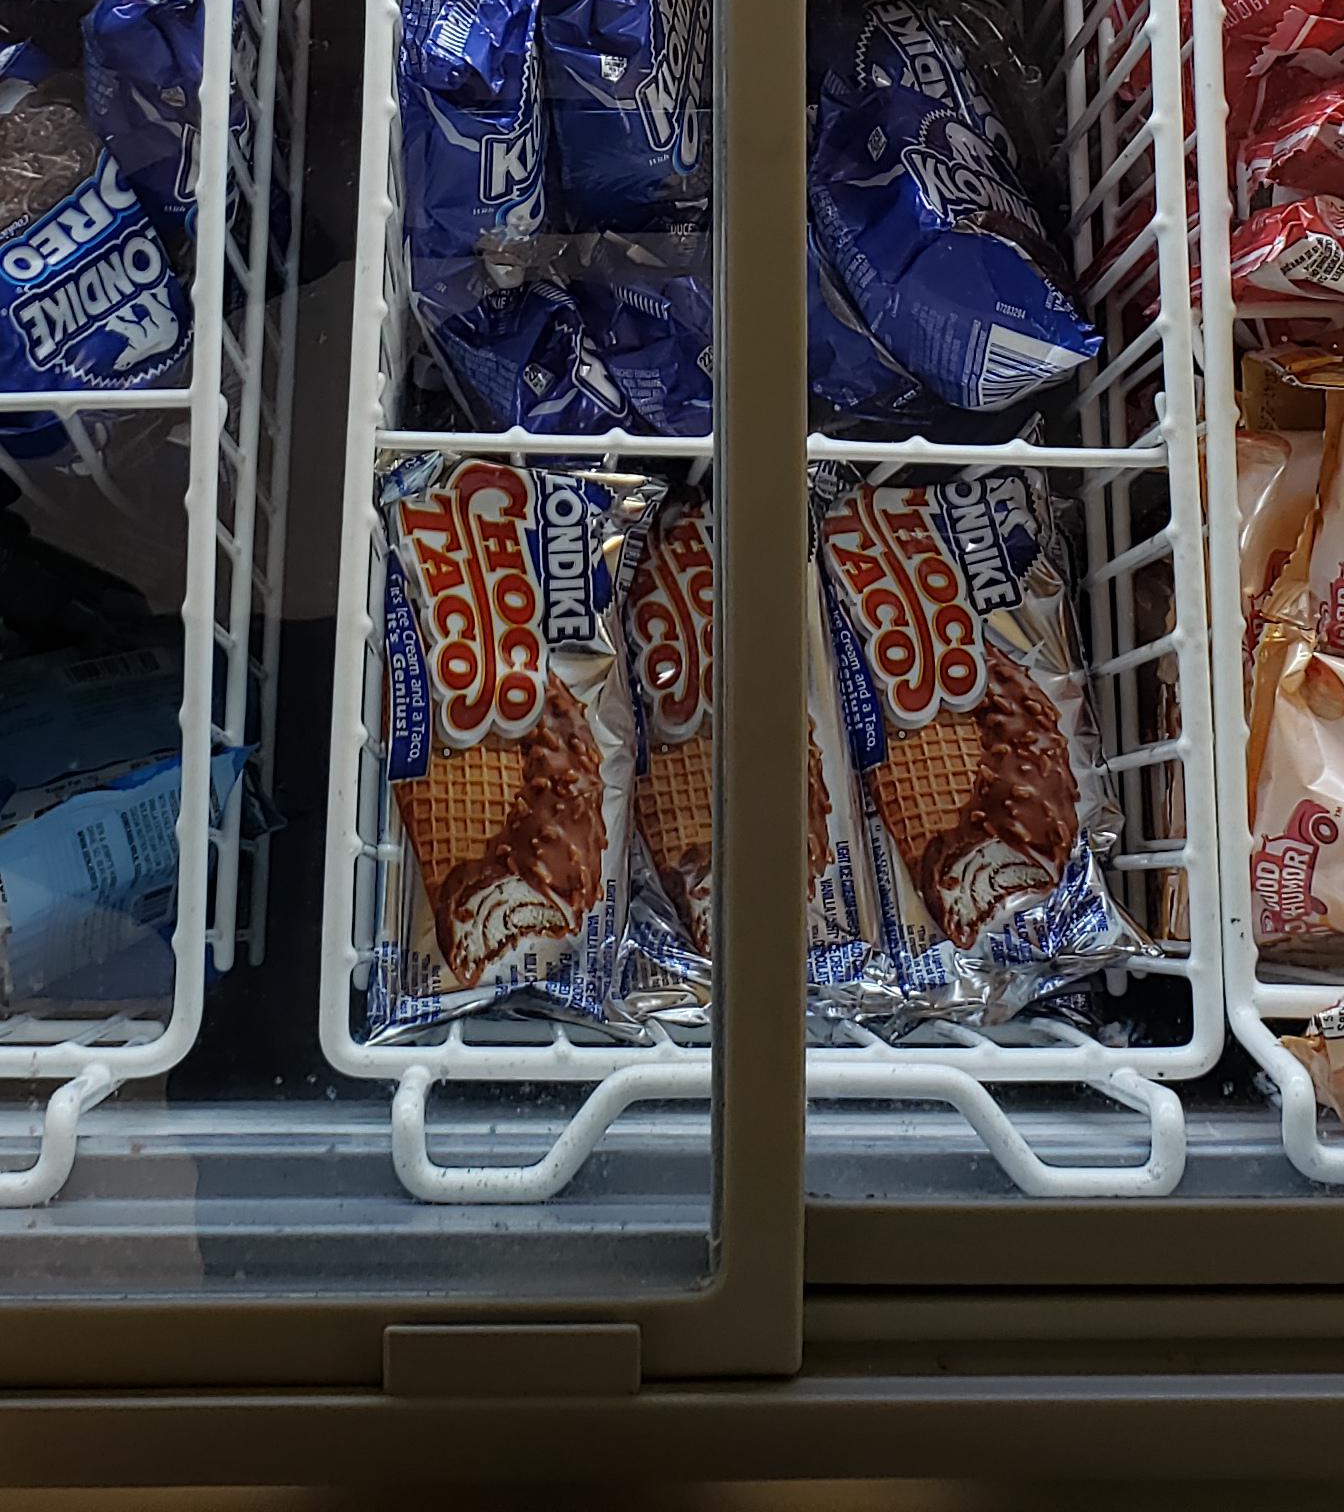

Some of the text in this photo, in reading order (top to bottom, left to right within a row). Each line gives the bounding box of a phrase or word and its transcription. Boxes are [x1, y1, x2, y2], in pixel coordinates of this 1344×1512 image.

[399, 492, 479, 690] TACO
[399, 607, 410, 628] Ice
[455, 462, 541, 722] CHOCO
[823, 497, 917, 677] TACO
[387, 612, 409, 738] It's Genius!
[403, 630, 419, 681] Cream
[840, 630, 860, 673] Cream
[854, 673, 868, 698] and
[410, 683, 423, 708] and
[407, 724, 426, 762] Taco,
